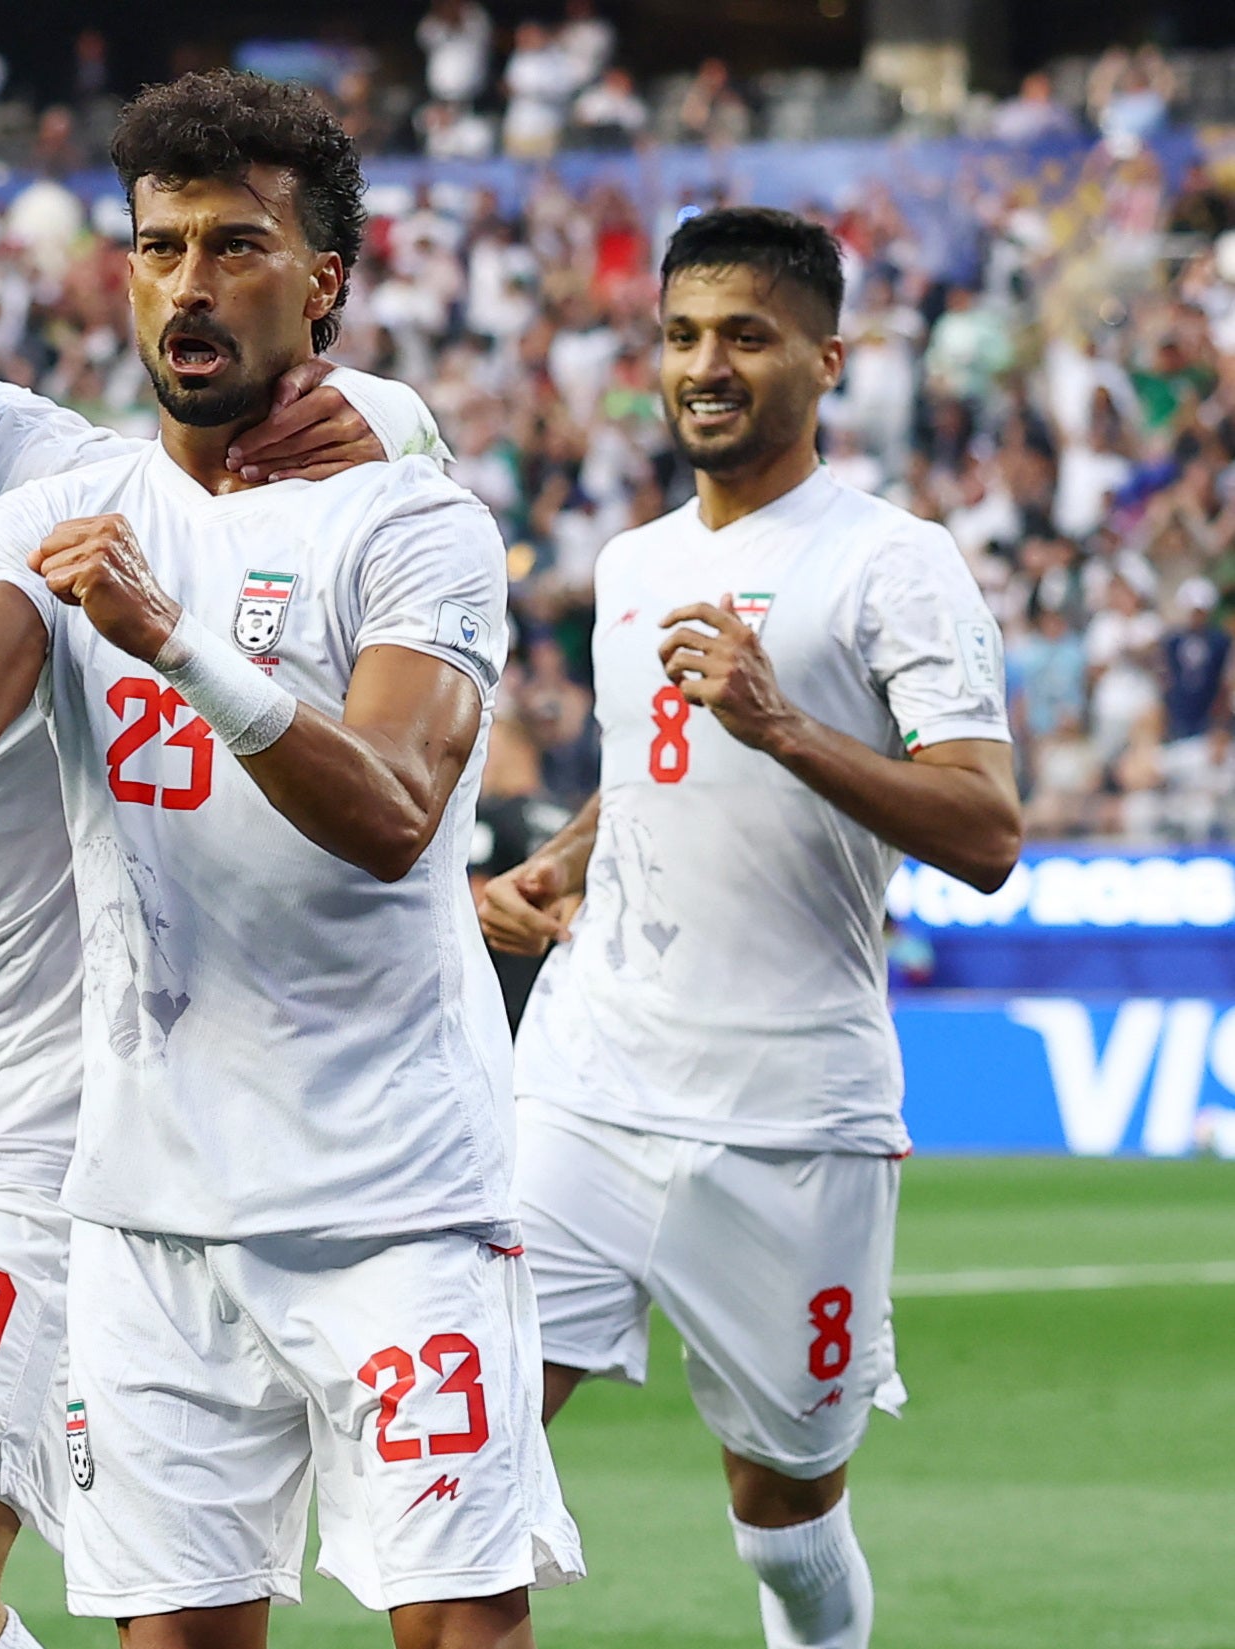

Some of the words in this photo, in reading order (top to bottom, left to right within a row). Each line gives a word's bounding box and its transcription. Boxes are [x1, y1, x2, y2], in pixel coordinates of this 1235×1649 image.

[105, 676, 215, 811] 23
[648, 684, 691, 785] 8
[809, 1286, 852, 1381] 8
[358, 1333, 490, 1463] 23
